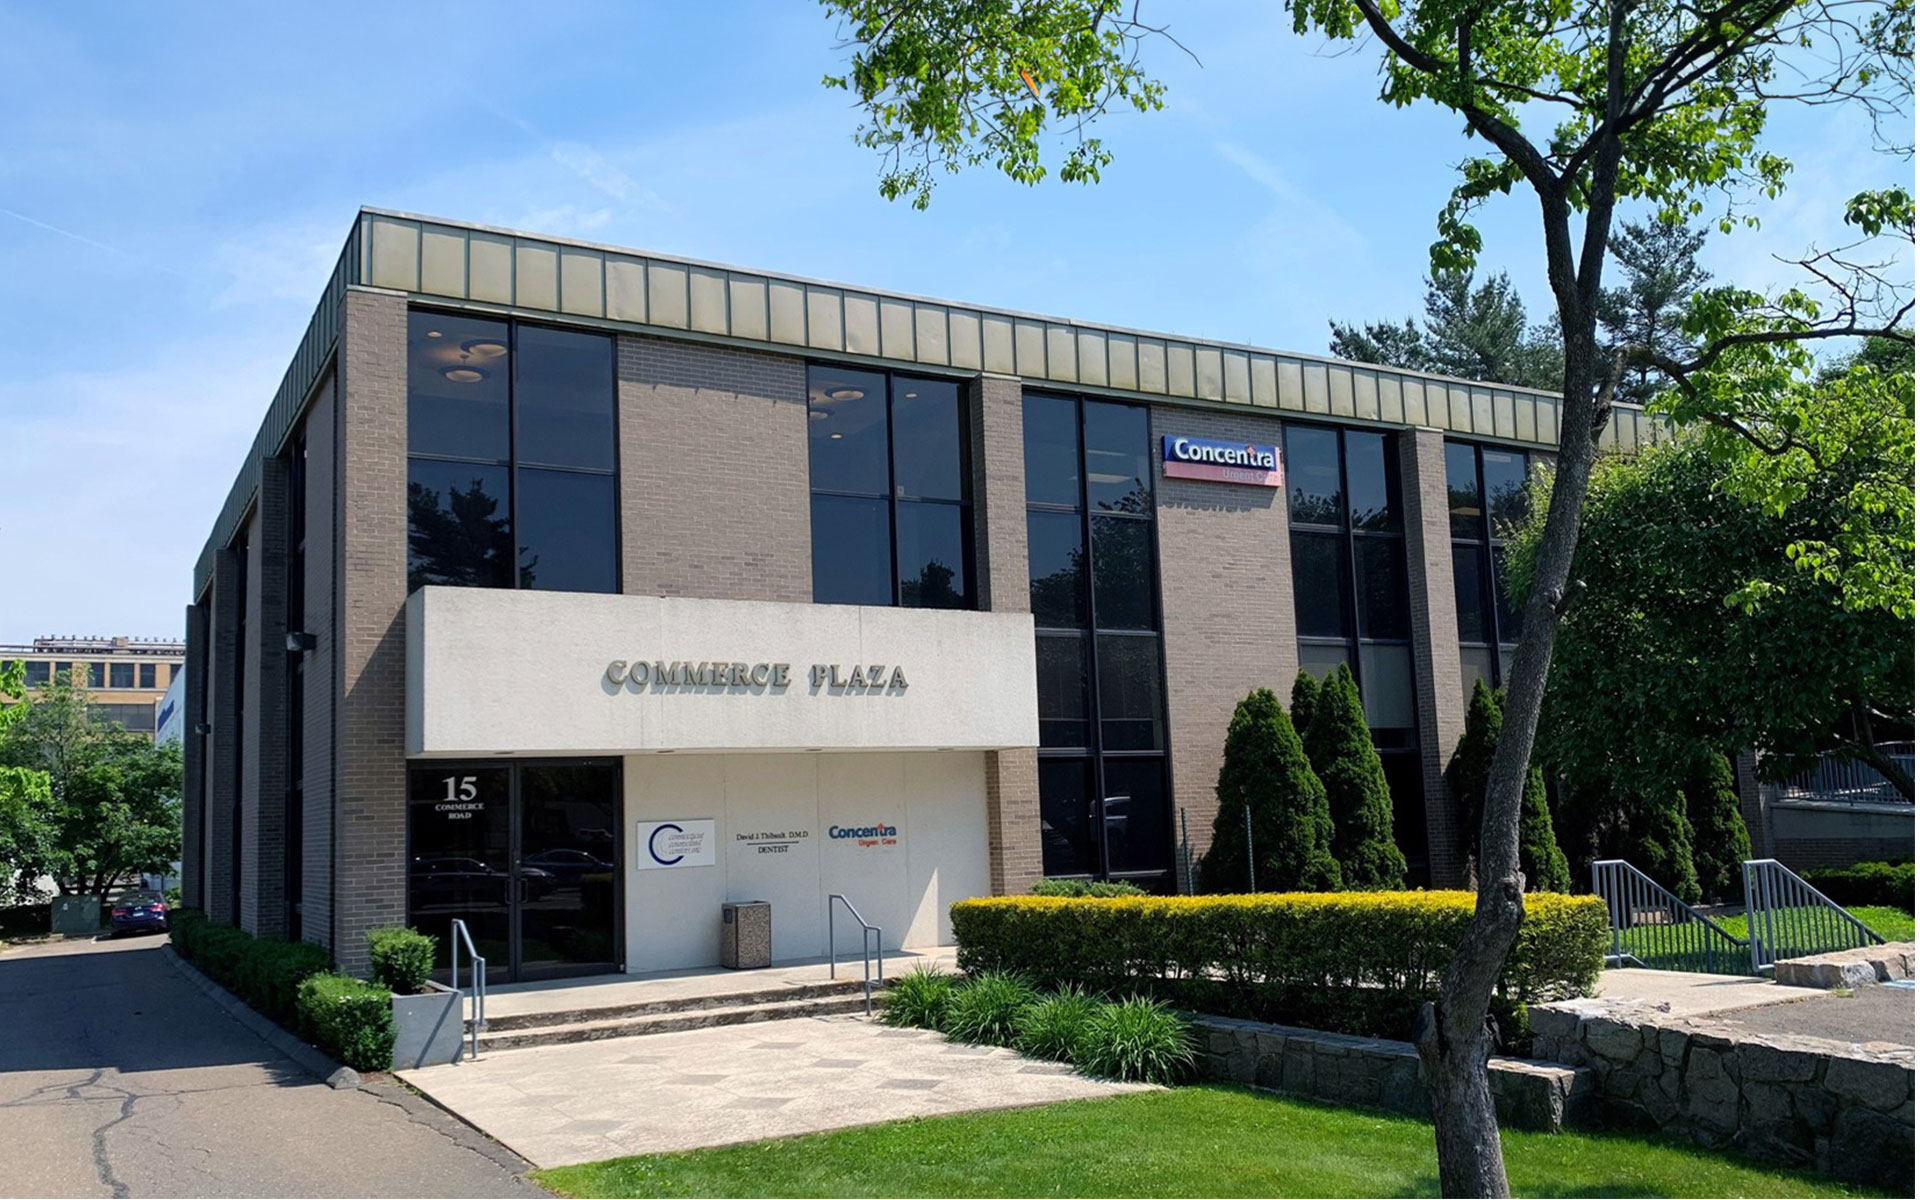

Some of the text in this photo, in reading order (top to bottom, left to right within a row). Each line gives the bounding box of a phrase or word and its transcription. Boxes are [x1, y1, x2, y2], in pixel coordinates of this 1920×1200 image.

[1174, 438, 1275, 468] Concentra
[606, 660, 909, 688] COMMERCE PLAZA
[442, 776, 477, 801] 15
[434, 802, 485, 812] COMMERCE
[448, 812, 472, 820] ROAD
[736, 833, 754, 841] David
[828, 822, 897, 839] Concentra
[758, 845, 789, 854] DENTIST
